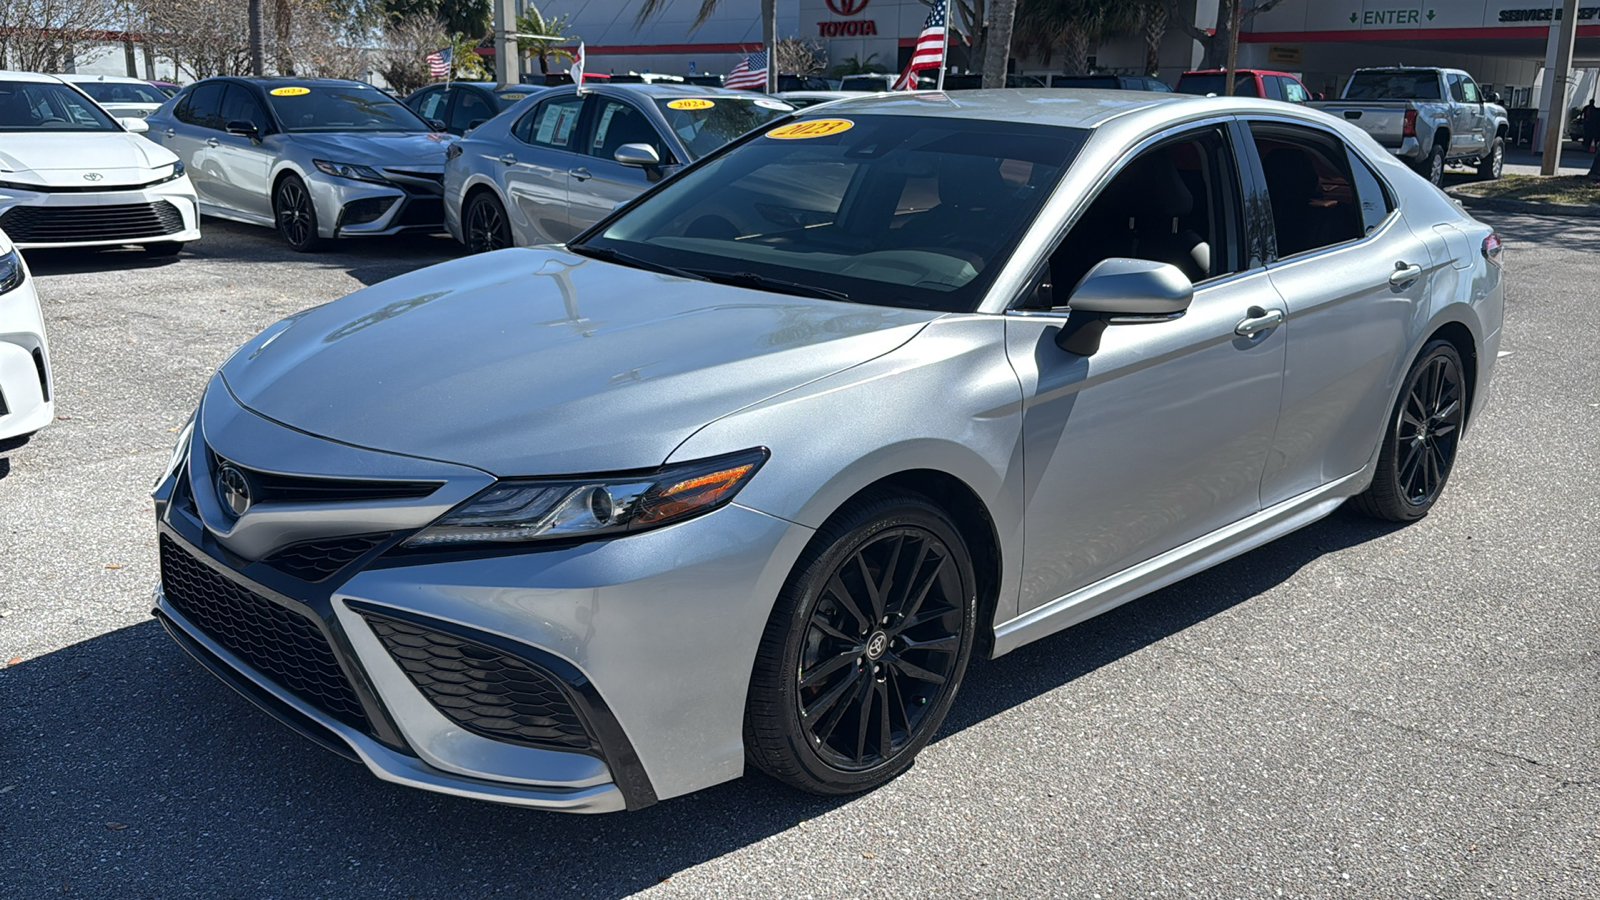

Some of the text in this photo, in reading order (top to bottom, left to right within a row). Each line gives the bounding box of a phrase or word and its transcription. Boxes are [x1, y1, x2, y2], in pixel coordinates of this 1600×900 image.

[1363, 9, 1420, 25] ENTER
[1498, 8, 1553, 22] SERVICE
[817, 20, 878, 37] TOYOTA
[676, 100, 706, 109] 2024
[774, 121, 844, 136] 2023
